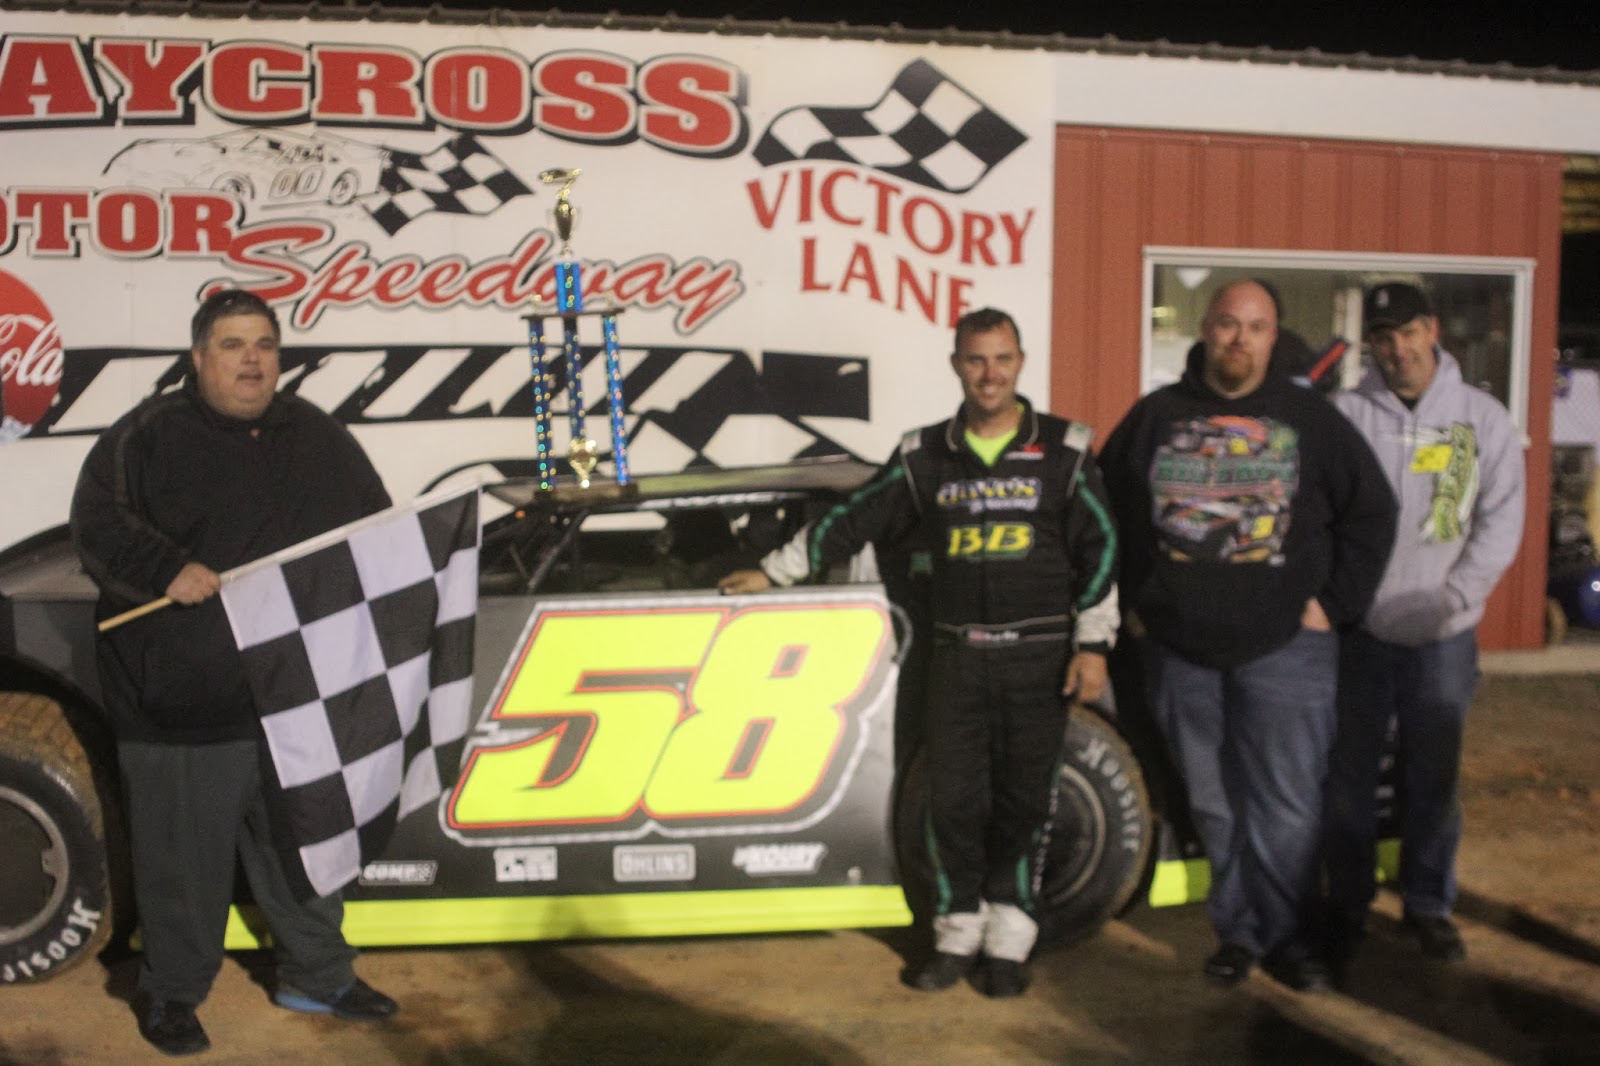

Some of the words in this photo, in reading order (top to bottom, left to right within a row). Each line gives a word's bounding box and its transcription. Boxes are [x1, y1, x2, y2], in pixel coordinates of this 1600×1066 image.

[0, 188, 242, 257] TOR
[199, 219, 744, 334] Speedway
[746, 167, 1035, 267] VICTORY
[801, 238, 975, 330] LANE
[446, 602, 892, 829] 58
